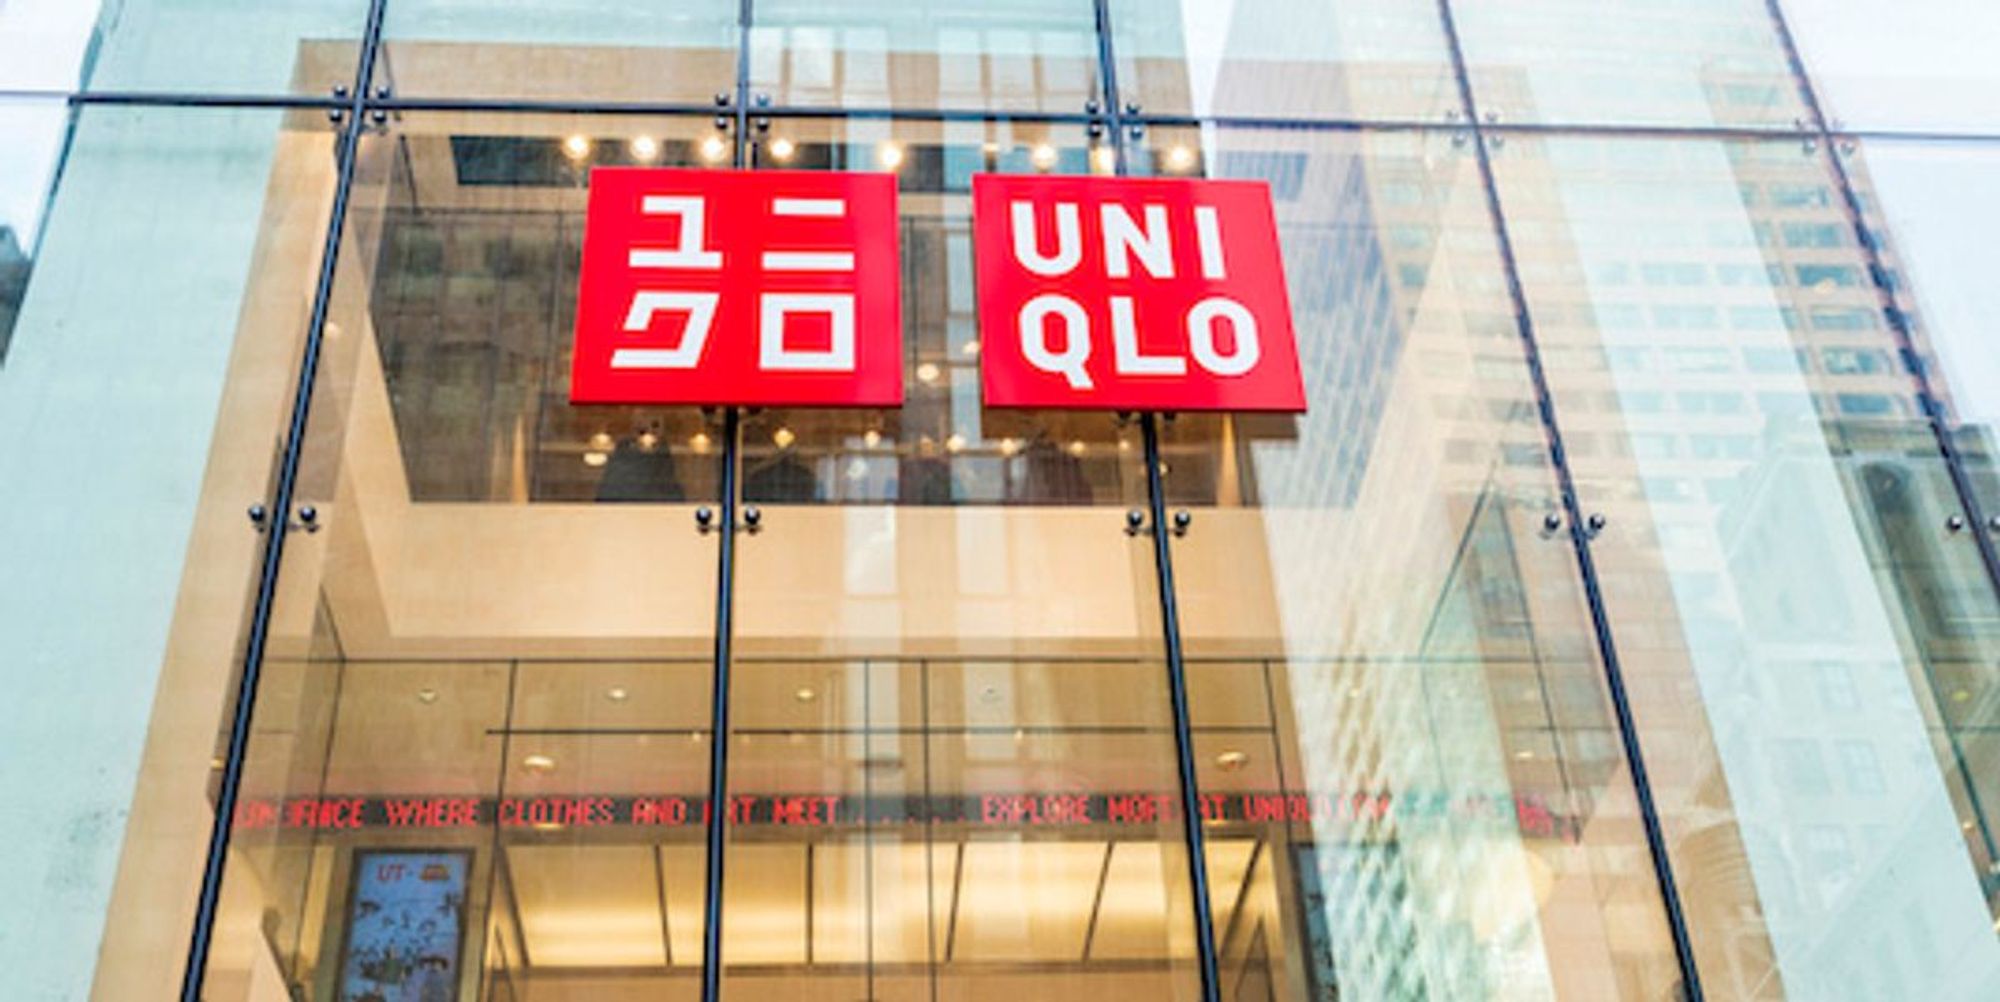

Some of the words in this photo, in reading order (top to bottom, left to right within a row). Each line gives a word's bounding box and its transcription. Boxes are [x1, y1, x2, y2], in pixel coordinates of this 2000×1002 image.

[628, 195, 855, 270] ユニ
[1011, 201, 1226, 280] UNI
[610, 290, 855, 371] クロ
[1018, 293, 1260, 389] QLO
[384, 797, 480, 828] WHERE
[500, 797, 615, 827] CLOTHES
[633, 797, 685, 826] AND
[772, 795, 839, 826] MEET
[981, 794, 1092, 825] EXPLORE
